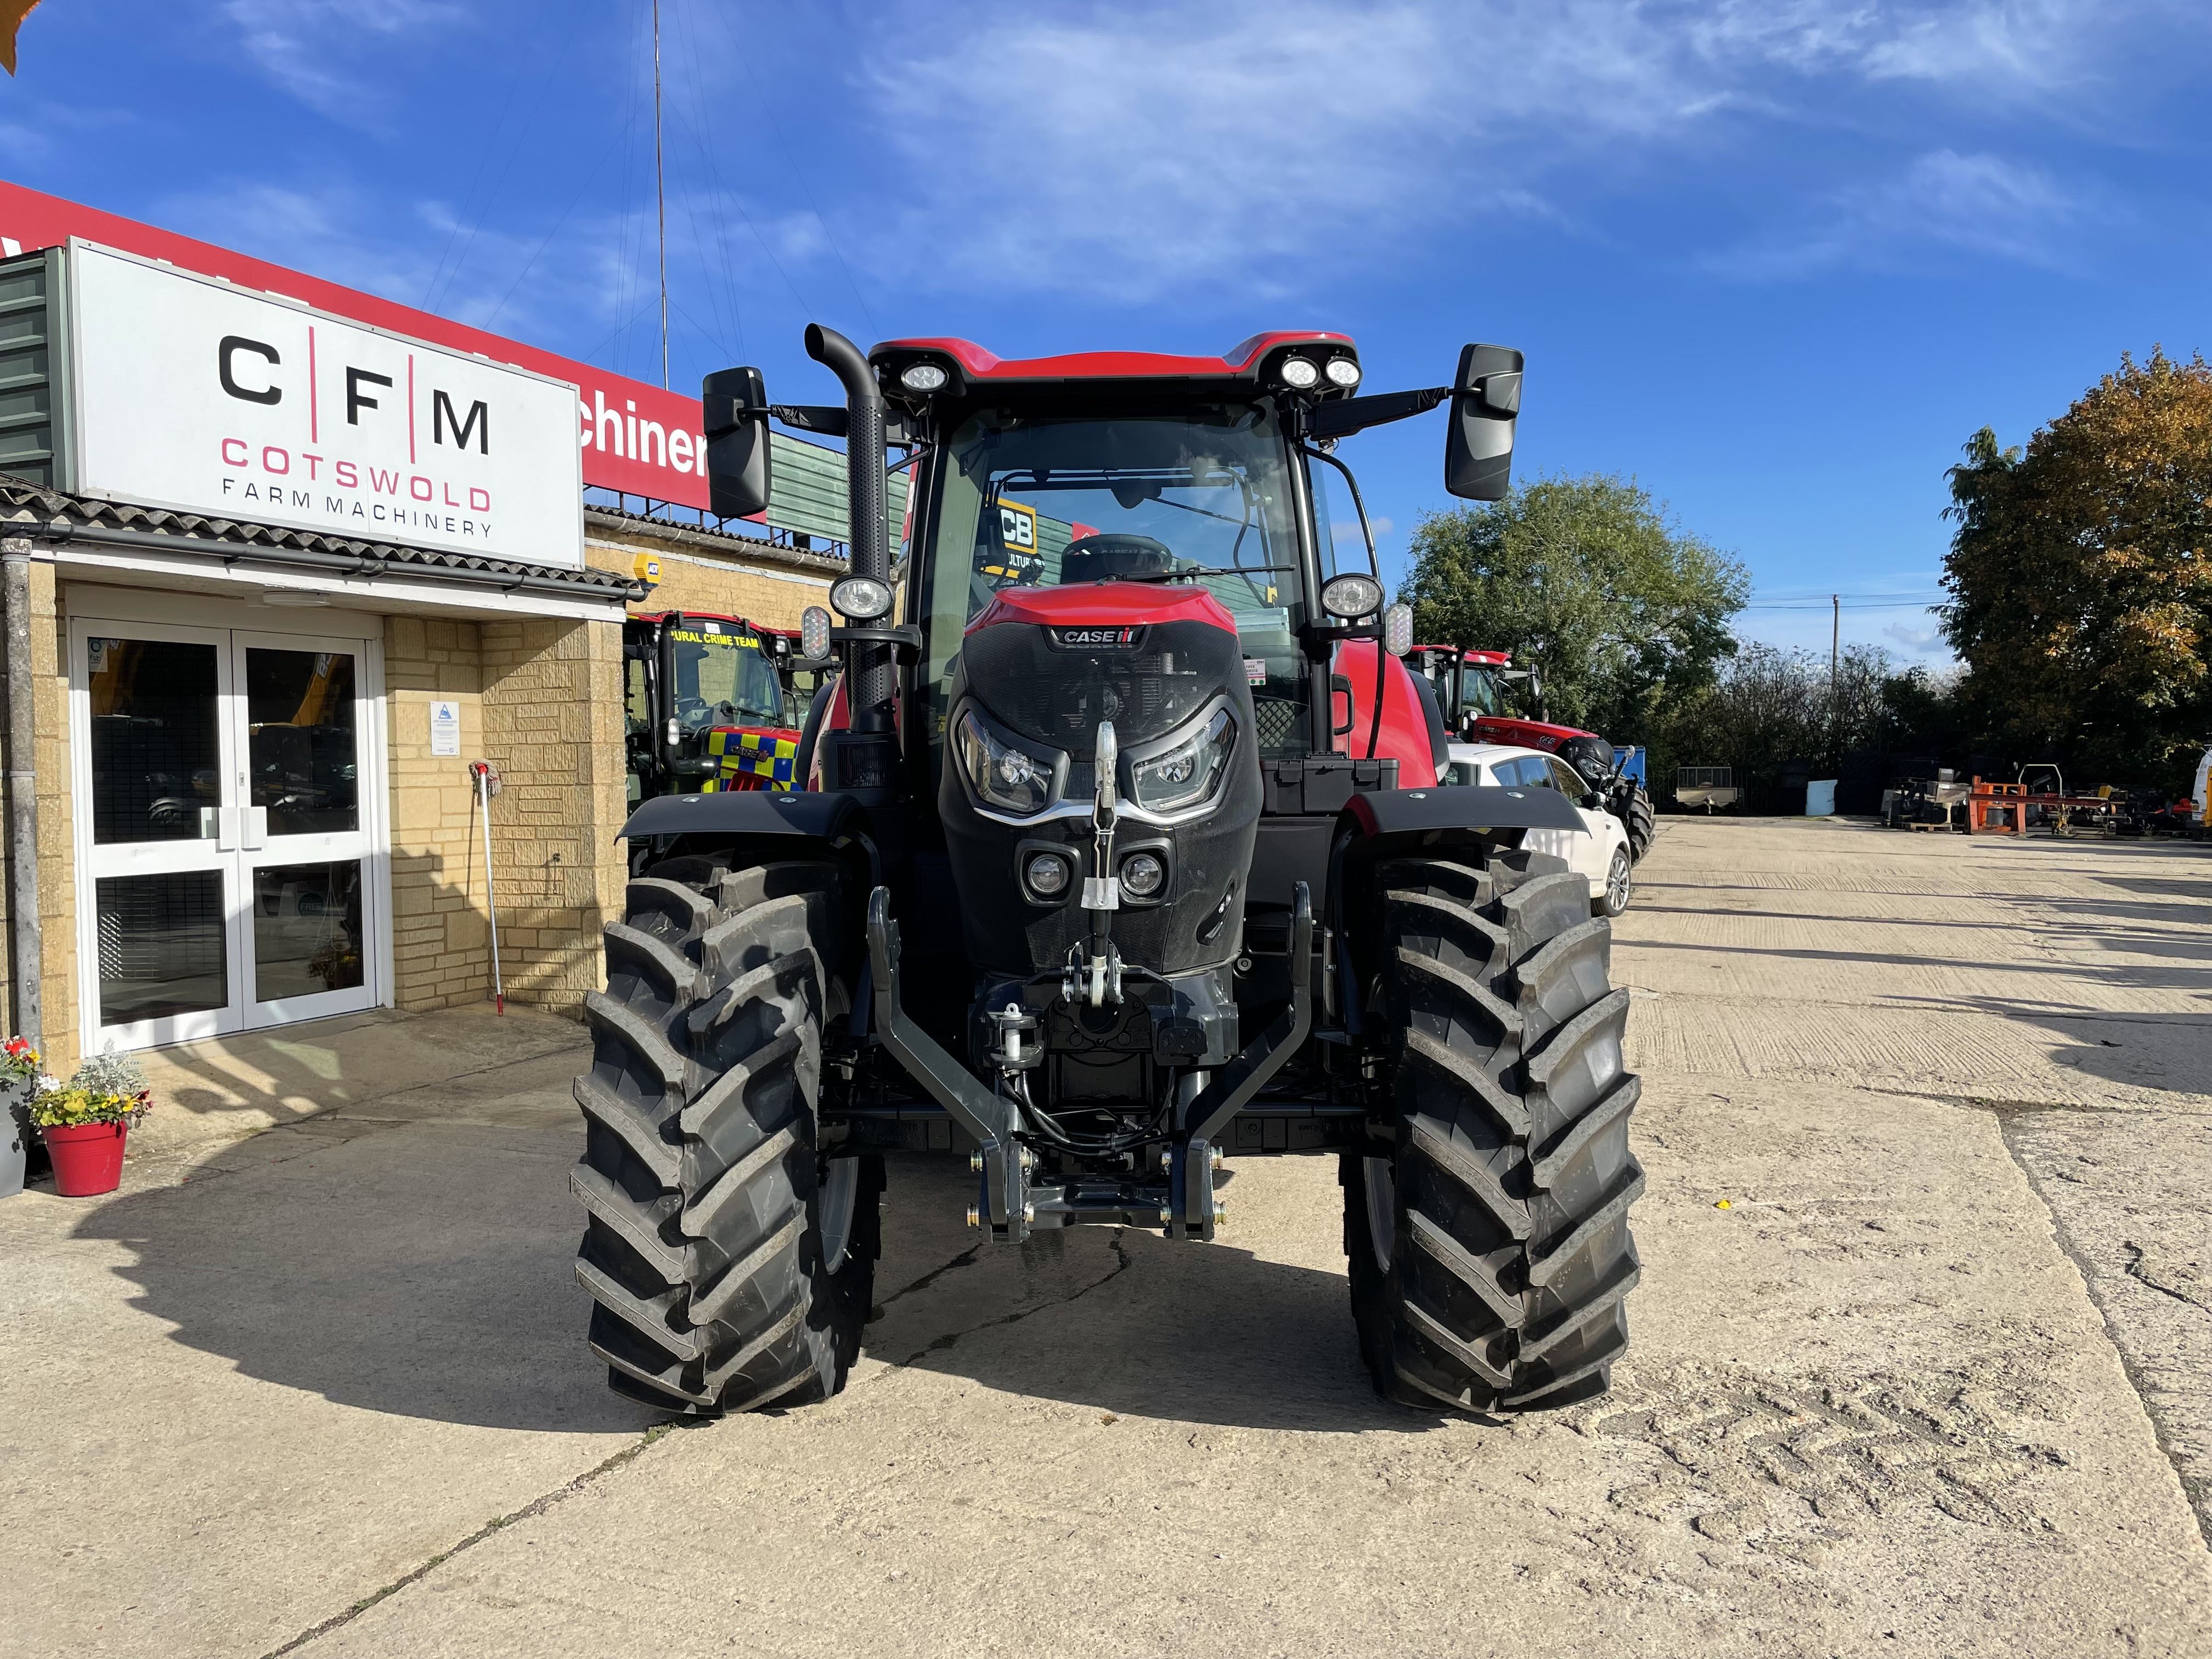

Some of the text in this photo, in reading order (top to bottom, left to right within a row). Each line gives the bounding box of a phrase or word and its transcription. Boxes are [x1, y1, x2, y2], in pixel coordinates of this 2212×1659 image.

[221, 438, 490, 512] COTSWOLD
[223, 478, 492, 538] FARM MACHINERY
[648, 564, 658, 574] ADT
[703, 633, 733, 646] CRIME
[733, 636, 759, 648] TEAM
[1064, 631, 1115, 643] CASE
[1539, 736, 1556, 745] 145
